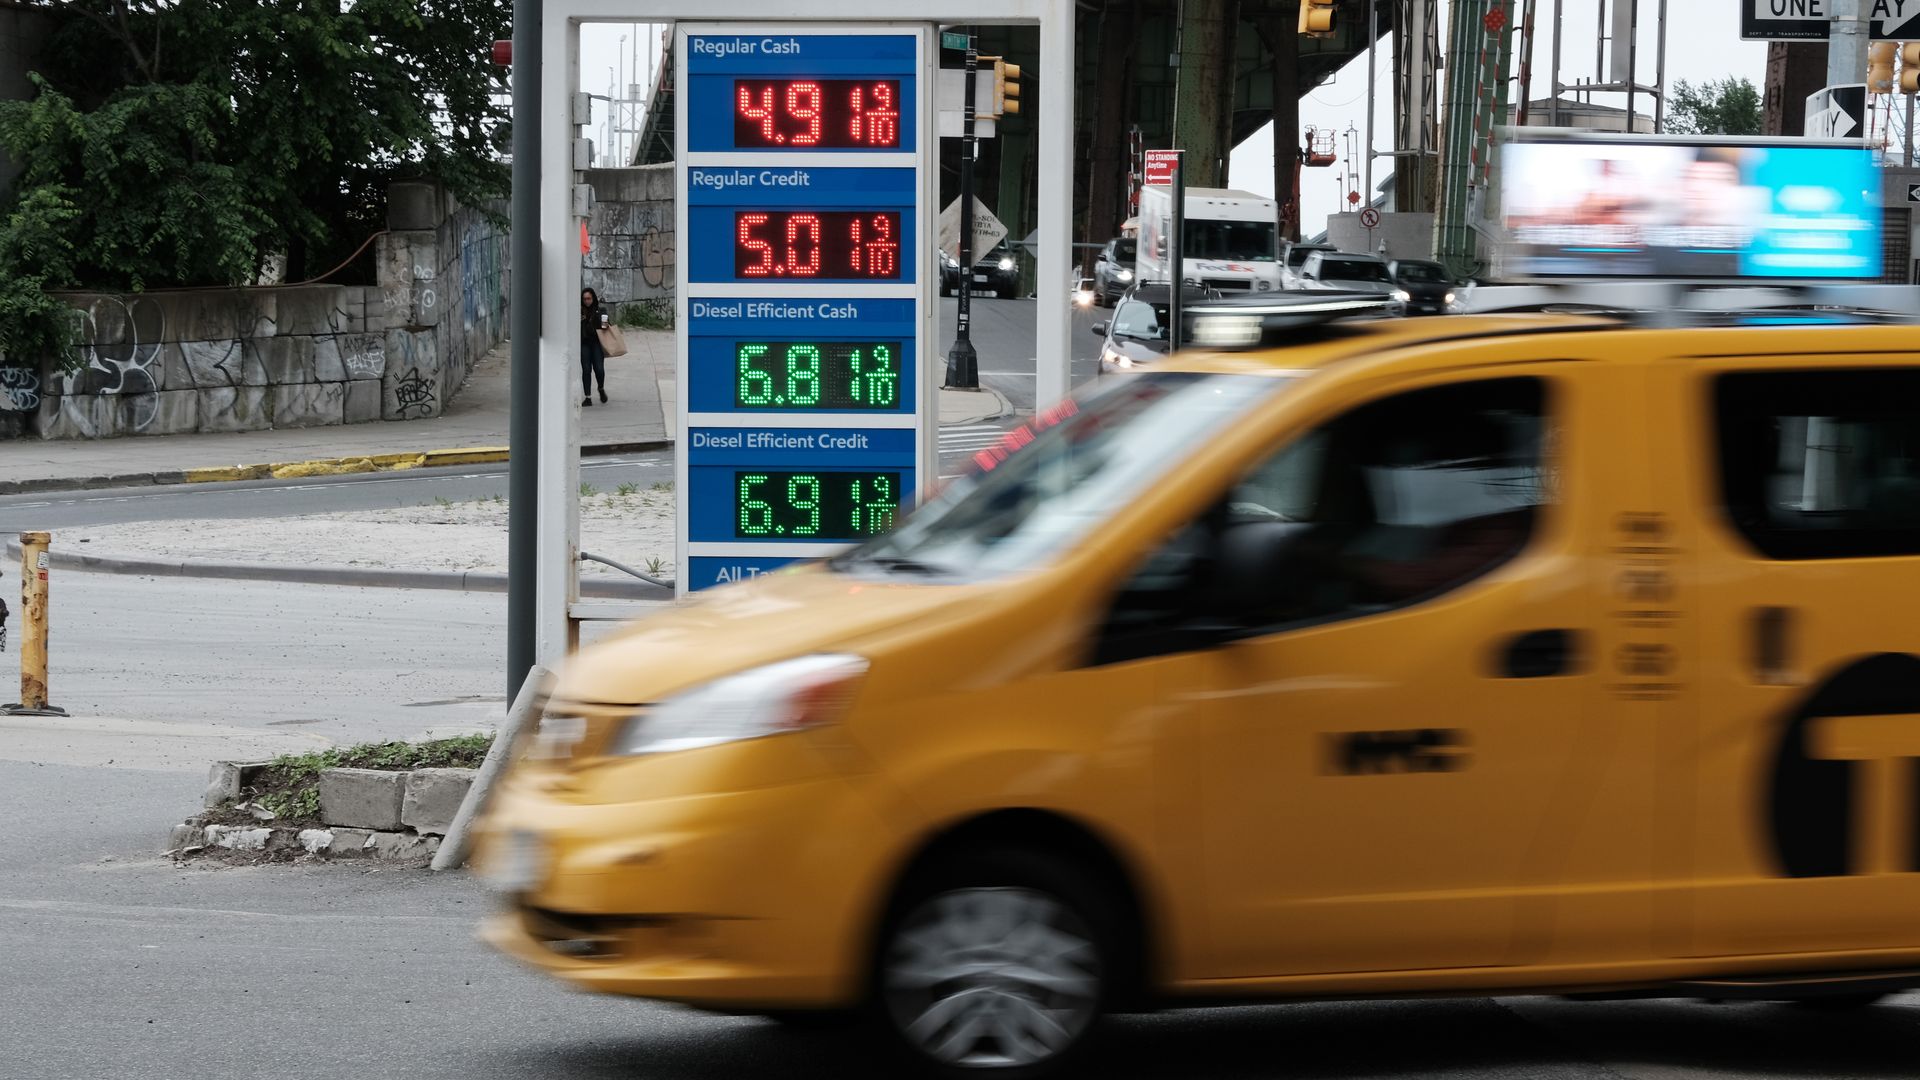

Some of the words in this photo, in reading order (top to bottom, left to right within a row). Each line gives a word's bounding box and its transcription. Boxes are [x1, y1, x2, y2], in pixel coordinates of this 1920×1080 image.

[1771, 0, 1823, 17] ONE
[1871, 0, 1908, 18] AY
[693, 38, 757, 58] Regular
[761, 38, 800, 54] Cash
[1147, 153, 1155, 161] NO
[1155, 153, 1178, 161] STANDING
[1147, 162, 1168, 170] Anytime
[693, 171, 756, 190] Regular
[760, 171, 810, 187] Credit
[693, 303, 742, 319] Diesel
[747, 303, 814, 319] Efficient
[818, 303, 858, 319] Cash
[693, 433, 742, 449] Diesel
[747, 433, 814, 449] Efficient
[818, 433, 869, 449] Credit
[715, 566, 742, 582] All
